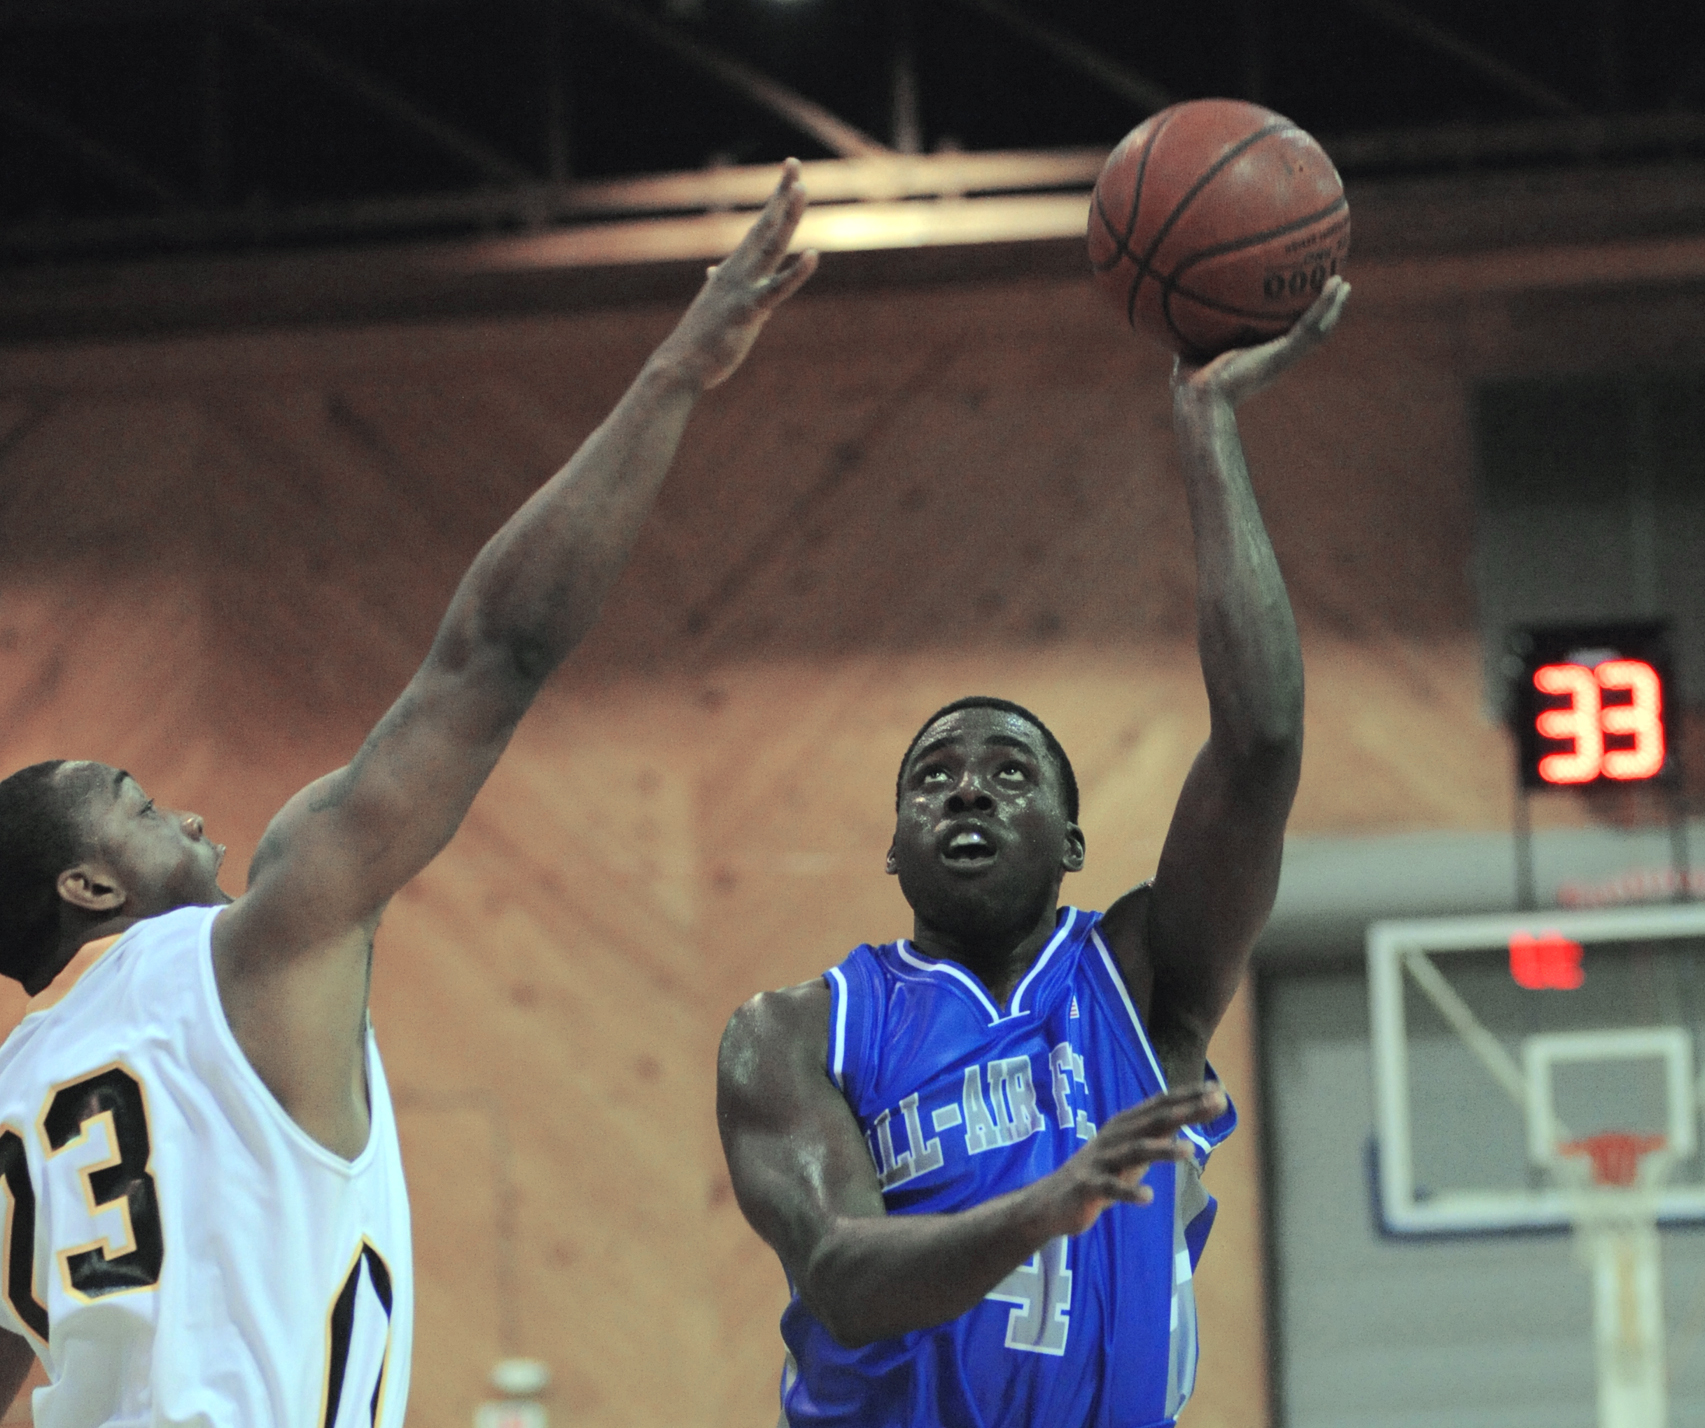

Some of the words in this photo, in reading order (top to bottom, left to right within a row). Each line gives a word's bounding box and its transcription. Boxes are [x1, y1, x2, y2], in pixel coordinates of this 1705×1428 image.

[1533, 659, 1665, 784] 33
[866, 1055, 1046, 1192] LL-AIR
[984, 1233, 1073, 1357] 4
